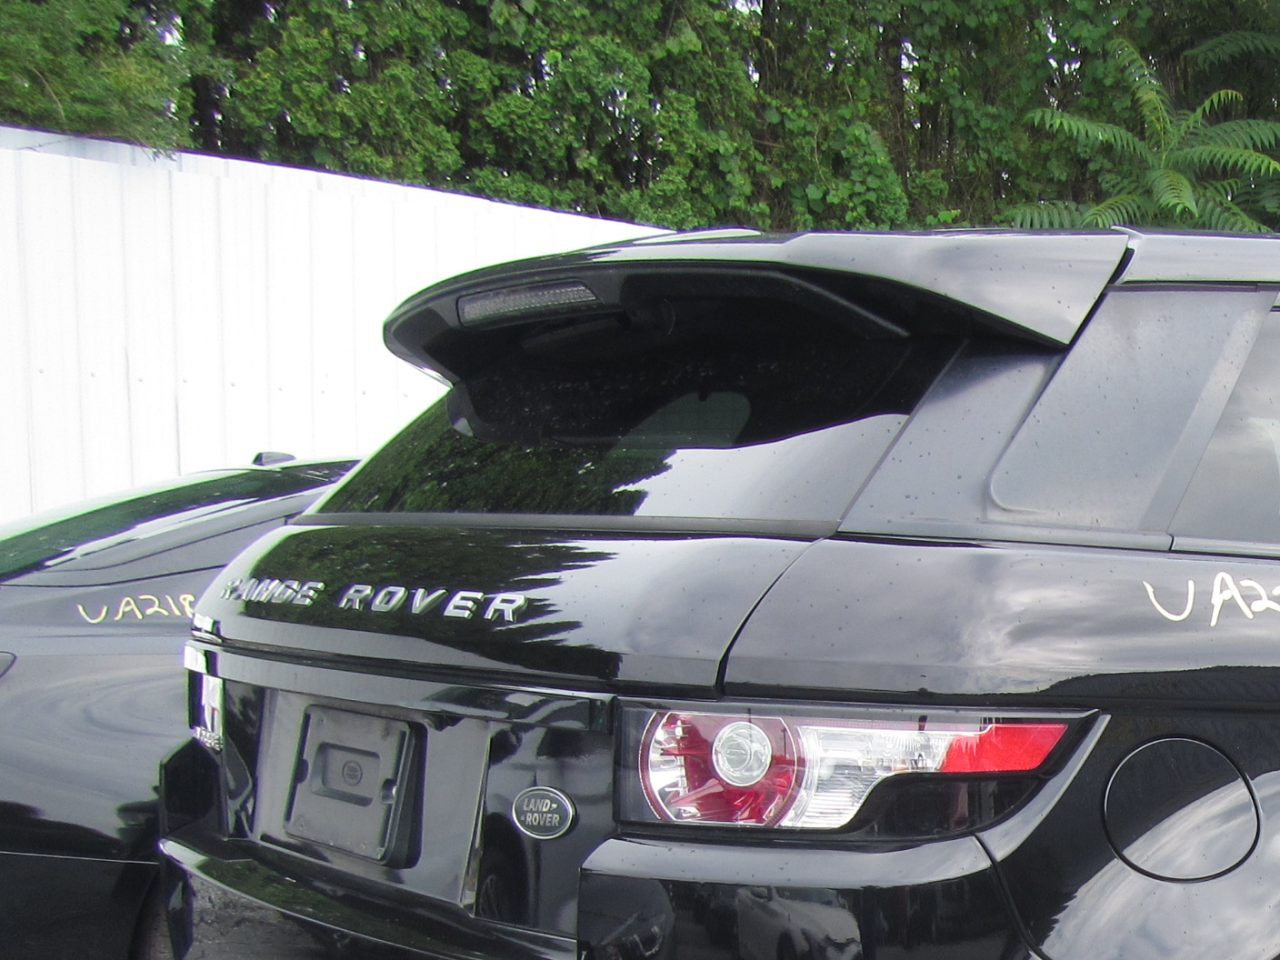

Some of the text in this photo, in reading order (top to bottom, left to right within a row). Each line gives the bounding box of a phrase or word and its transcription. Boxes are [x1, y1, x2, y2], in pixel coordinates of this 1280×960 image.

[219, 577, 528, 622] RANGE ROVER
[523, 798, 551, 812] LAND
[525, 812, 560, 827] ROVER
